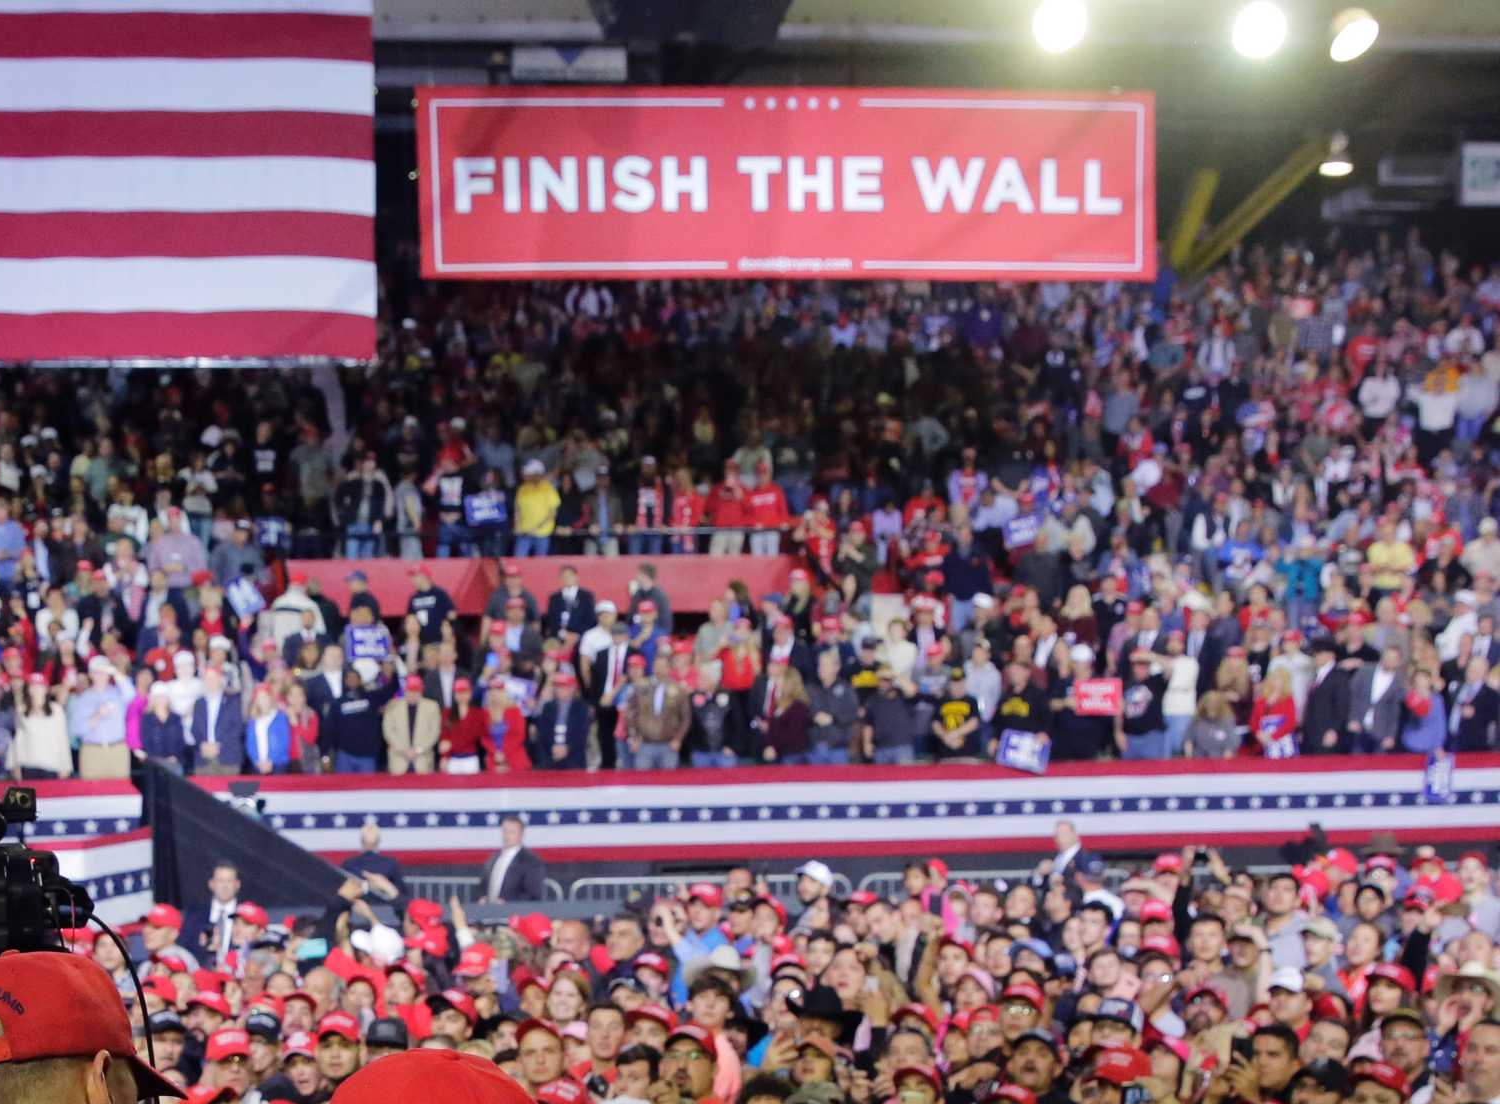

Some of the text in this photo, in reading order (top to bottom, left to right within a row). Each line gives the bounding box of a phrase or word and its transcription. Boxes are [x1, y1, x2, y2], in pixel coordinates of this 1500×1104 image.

[453, 155, 1124, 216] FINISH THE WALL
